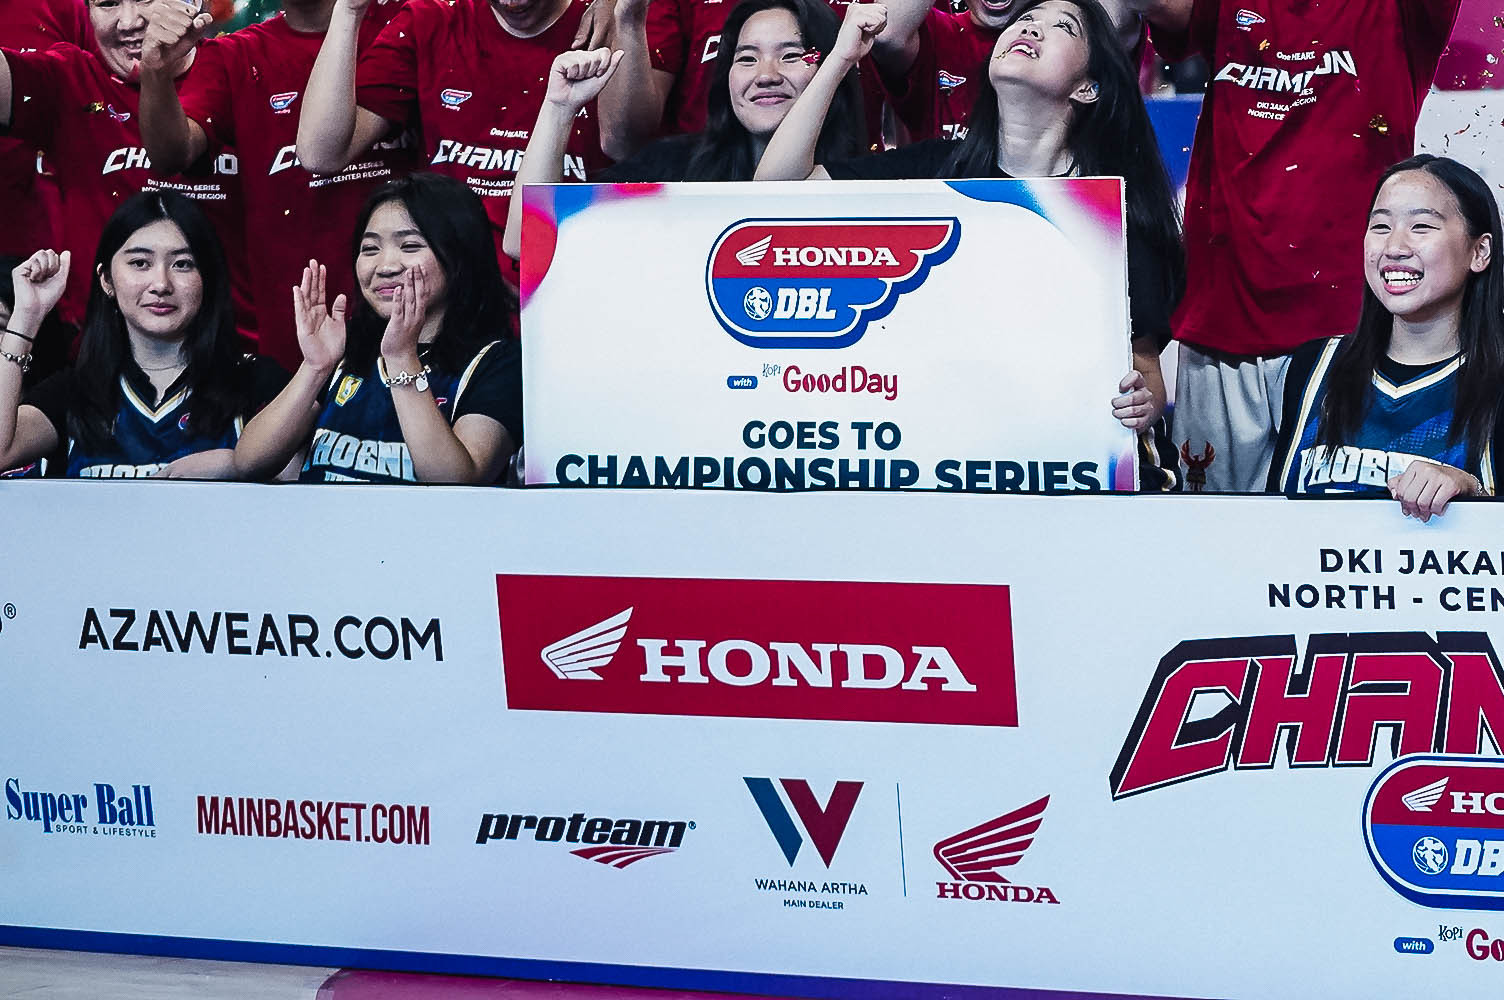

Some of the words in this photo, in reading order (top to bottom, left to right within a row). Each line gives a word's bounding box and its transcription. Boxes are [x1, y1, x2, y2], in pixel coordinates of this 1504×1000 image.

[332, 172, 361, 182] CENTER
[362, 168, 391, 178] REGION
[772, 247, 899, 267] HONDA
[772, 287, 838, 321] DBL
[733, 377, 752, 387] with
[742, 420, 840, 451] GOES
[850, 421, 902, 451] TO
[556, 454, 919, 489] CHAMPIONSHIP
[935, 459, 1100, 491] SERIES
[1319, 548, 1383, 574] DKI
[1268, 583, 1396, 610] NORTH
[79, 607, 443, 661] AZAWEAR.COM
[636, 638, 977, 692] HONDA
[5, 778, 88, 833] Super
[93, 783, 156, 827] Ball
[56, 824, 88, 834] SPORT
[103, 827, 156, 838] LIFESTYLE
[196, 795, 430, 845] MAINBASKET.COM
[755, 878, 818, 893] WAHANA
[821, 881, 868, 896] ARTHA
[936, 881, 1060, 905] HONDA
[783, 899, 807, 908] MAIN
[809, 900, 844, 910] DEALER
[1402, 940, 1427, 951] with
